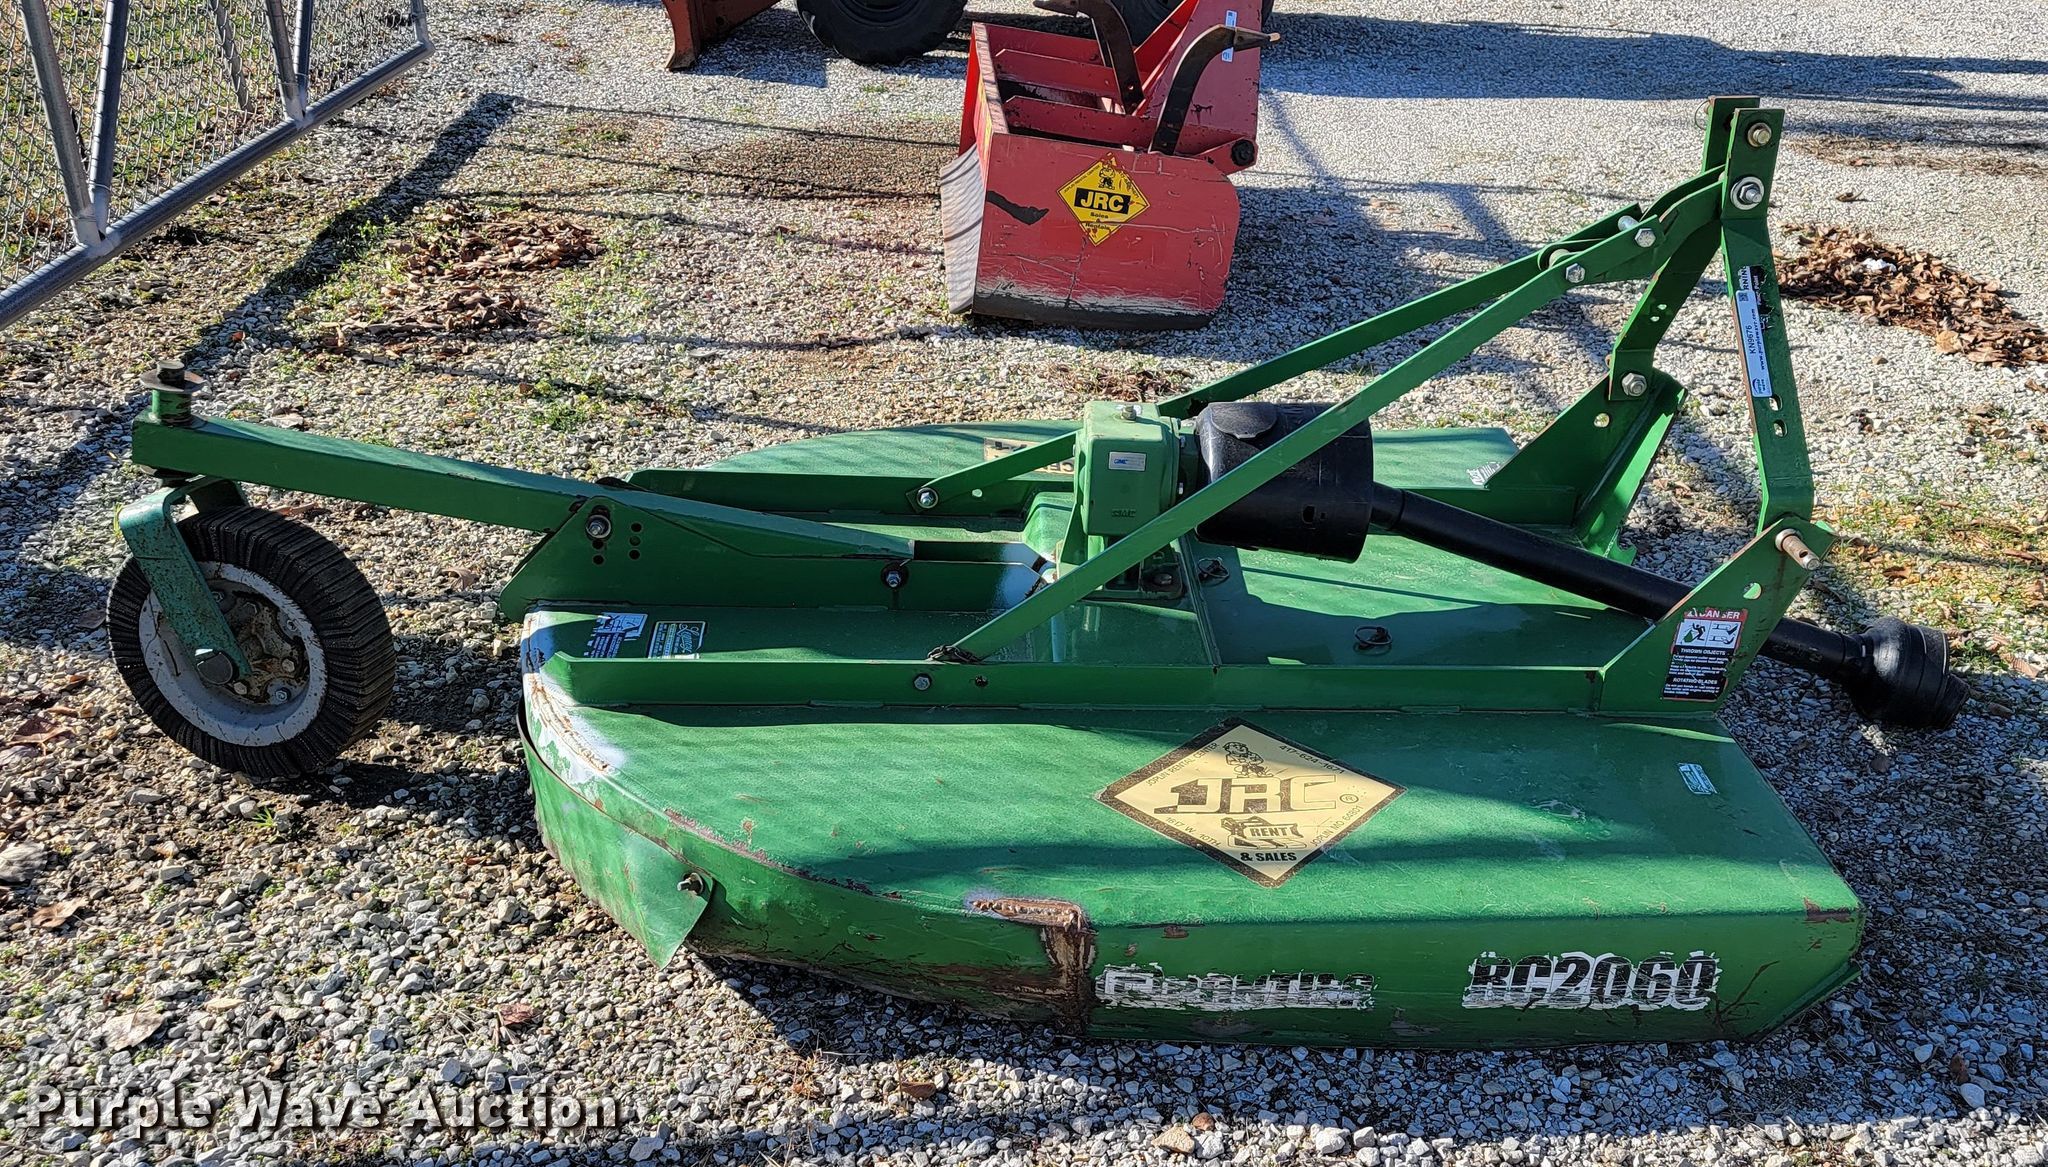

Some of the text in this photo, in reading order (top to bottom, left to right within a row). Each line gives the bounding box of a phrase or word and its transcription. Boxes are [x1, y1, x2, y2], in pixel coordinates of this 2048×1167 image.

[1080, 191, 1124, 211] JRC
[1745, 325, 1757, 354] KN9676
[1146, 742, 1218, 787] JOPLIN RENTAL CENTER
[1279, 744, 1346, 775] 417-624-1671
[1154, 775, 1337, 815] JRC
[1184, 825, 1197, 835] W
[1249, 827, 1288, 837] RENT
[1310, 828, 1334, 847] JOPLIN
[1330, 819, 1345, 833] MO
[1240, 852, 1297, 861] & SALES
